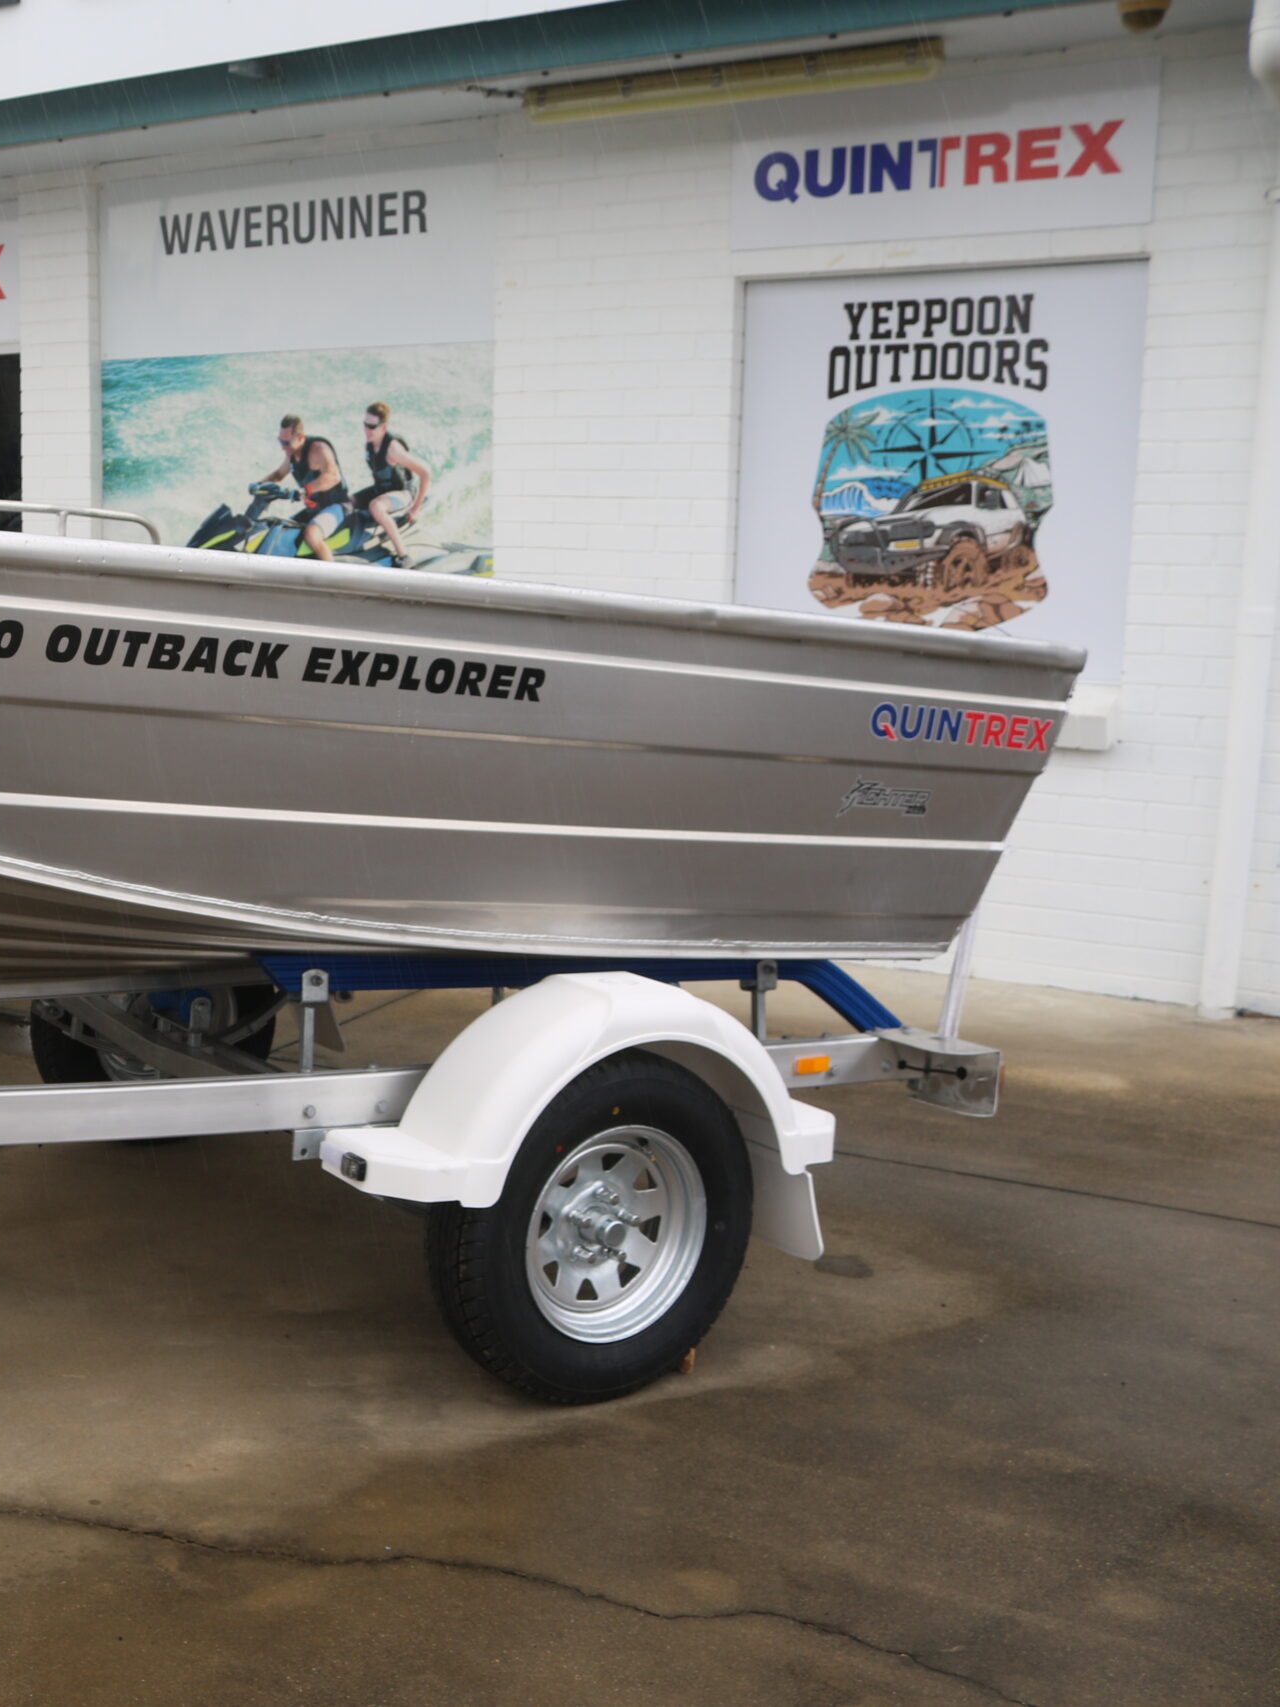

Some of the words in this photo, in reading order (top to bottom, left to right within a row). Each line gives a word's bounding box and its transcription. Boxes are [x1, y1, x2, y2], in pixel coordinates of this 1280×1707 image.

[754, 119, 1125, 204] QUINTREX
[159, 190, 428, 256] WAVERUNNER
[844, 293, 1035, 340] YEPPOON
[827, 338, 1049, 400] OUTDOORS
[45, 624, 289, 680] OUTBACK
[302, 646, 546, 702] EXPLORER
[871, 702, 1054, 752] QUINTREX
